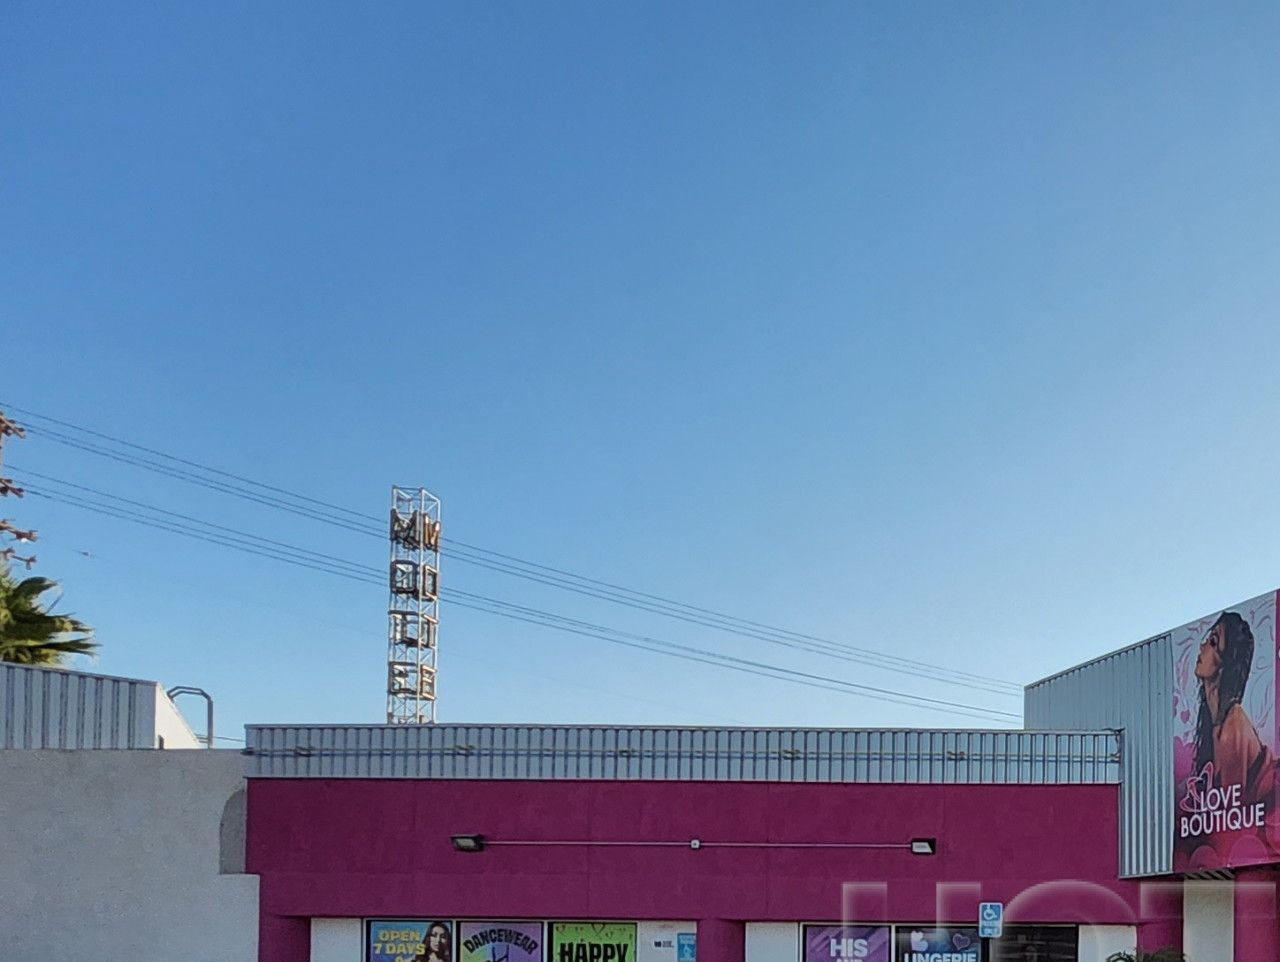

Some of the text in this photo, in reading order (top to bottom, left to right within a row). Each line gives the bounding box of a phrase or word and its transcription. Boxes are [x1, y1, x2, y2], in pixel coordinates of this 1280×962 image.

[389, 508, 422, 724] MOTE
[1201, 784, 1241, 812] LOVE
[1180, 803, 1265, 838] BOUTIQUE
[374, 943, 426, 955] 7 DAYS
[379, 930, 420, 942] OPEN
[463, 928, 539, 955] DANCEWEAR
[829, 938, 868, 958] HIS
